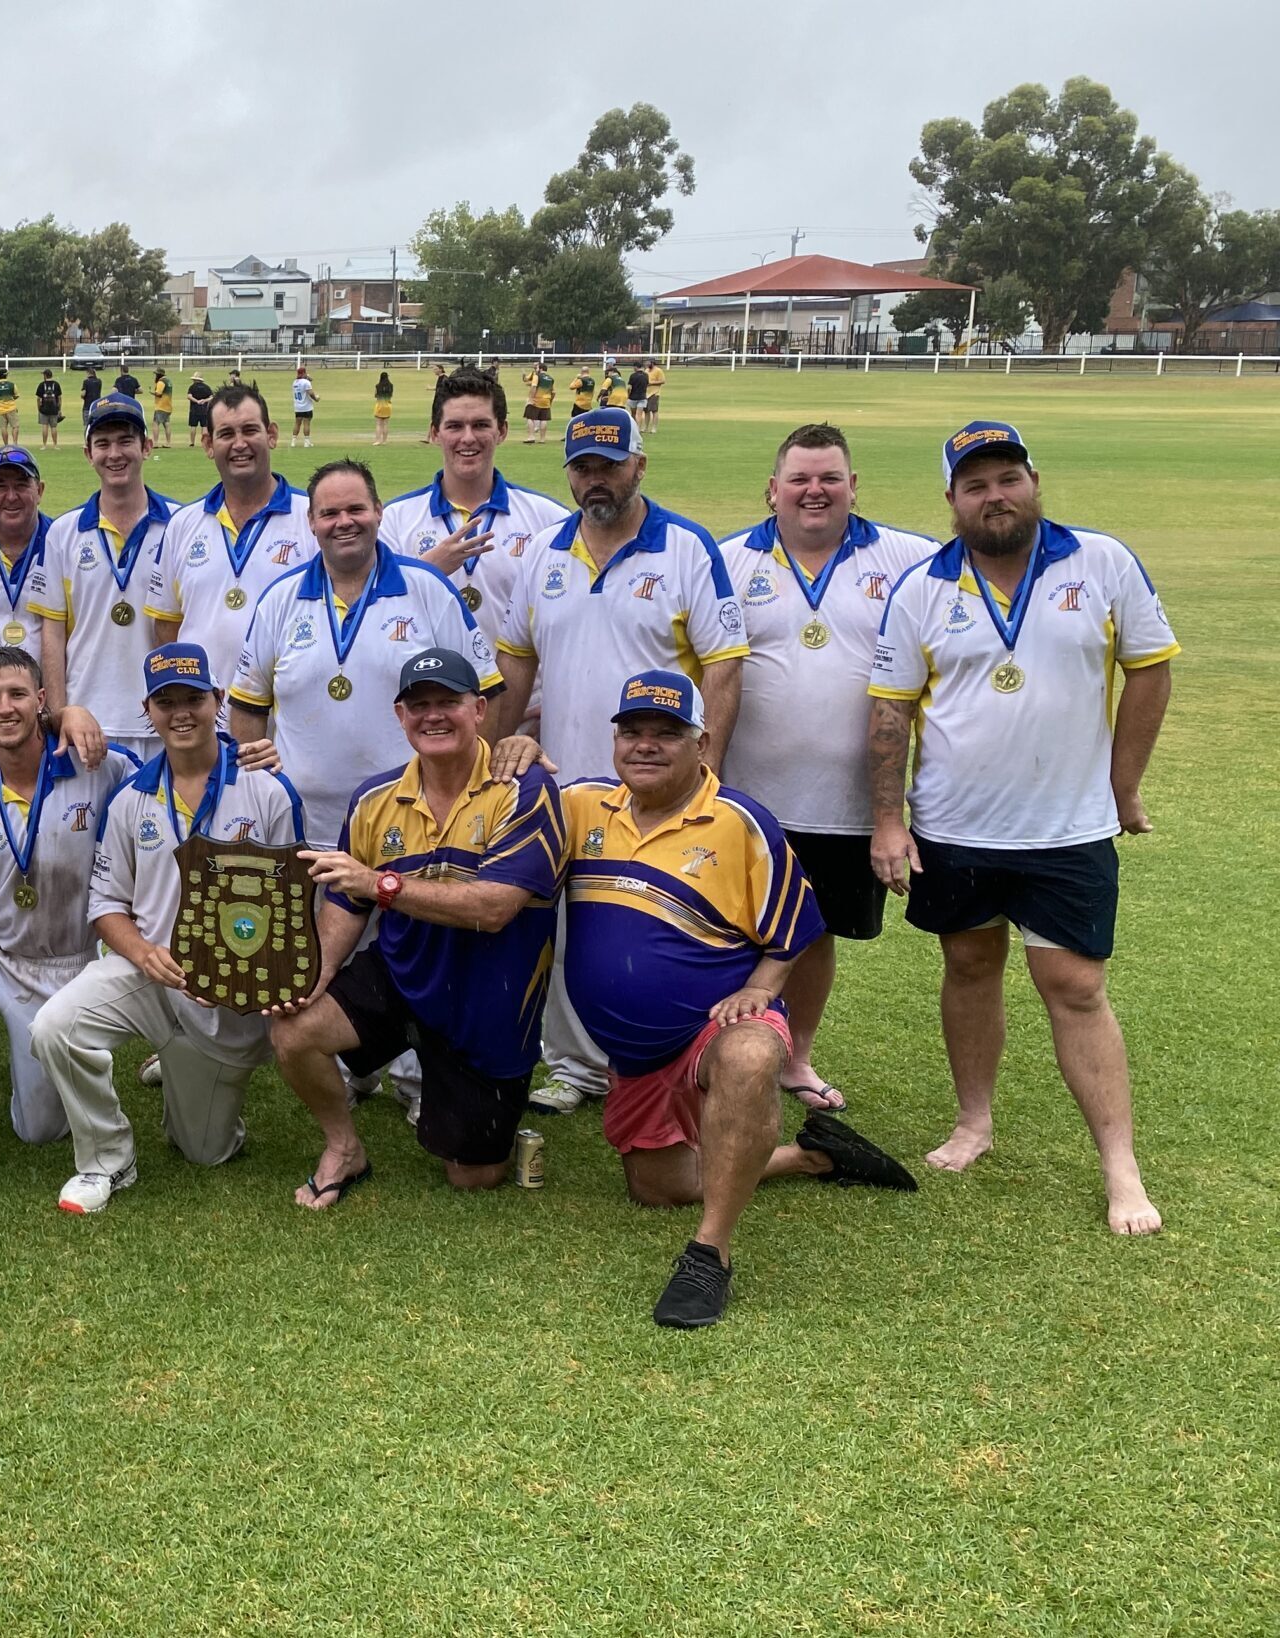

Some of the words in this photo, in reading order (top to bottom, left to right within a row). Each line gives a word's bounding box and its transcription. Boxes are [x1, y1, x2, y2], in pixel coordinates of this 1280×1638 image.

[572, 421, 585, 432] RSL
[572, 425, 620, 440] CRICKET
[595, 435, 619, 443] CLUB
[151, 654, 163, 664] RSL
[151, 658, 199, 673] CRICKET
[629, 680, 642, 689] RSL
[627, 686, 682, 700] CRICKET
[653, 697, 680, 708] CLUB
